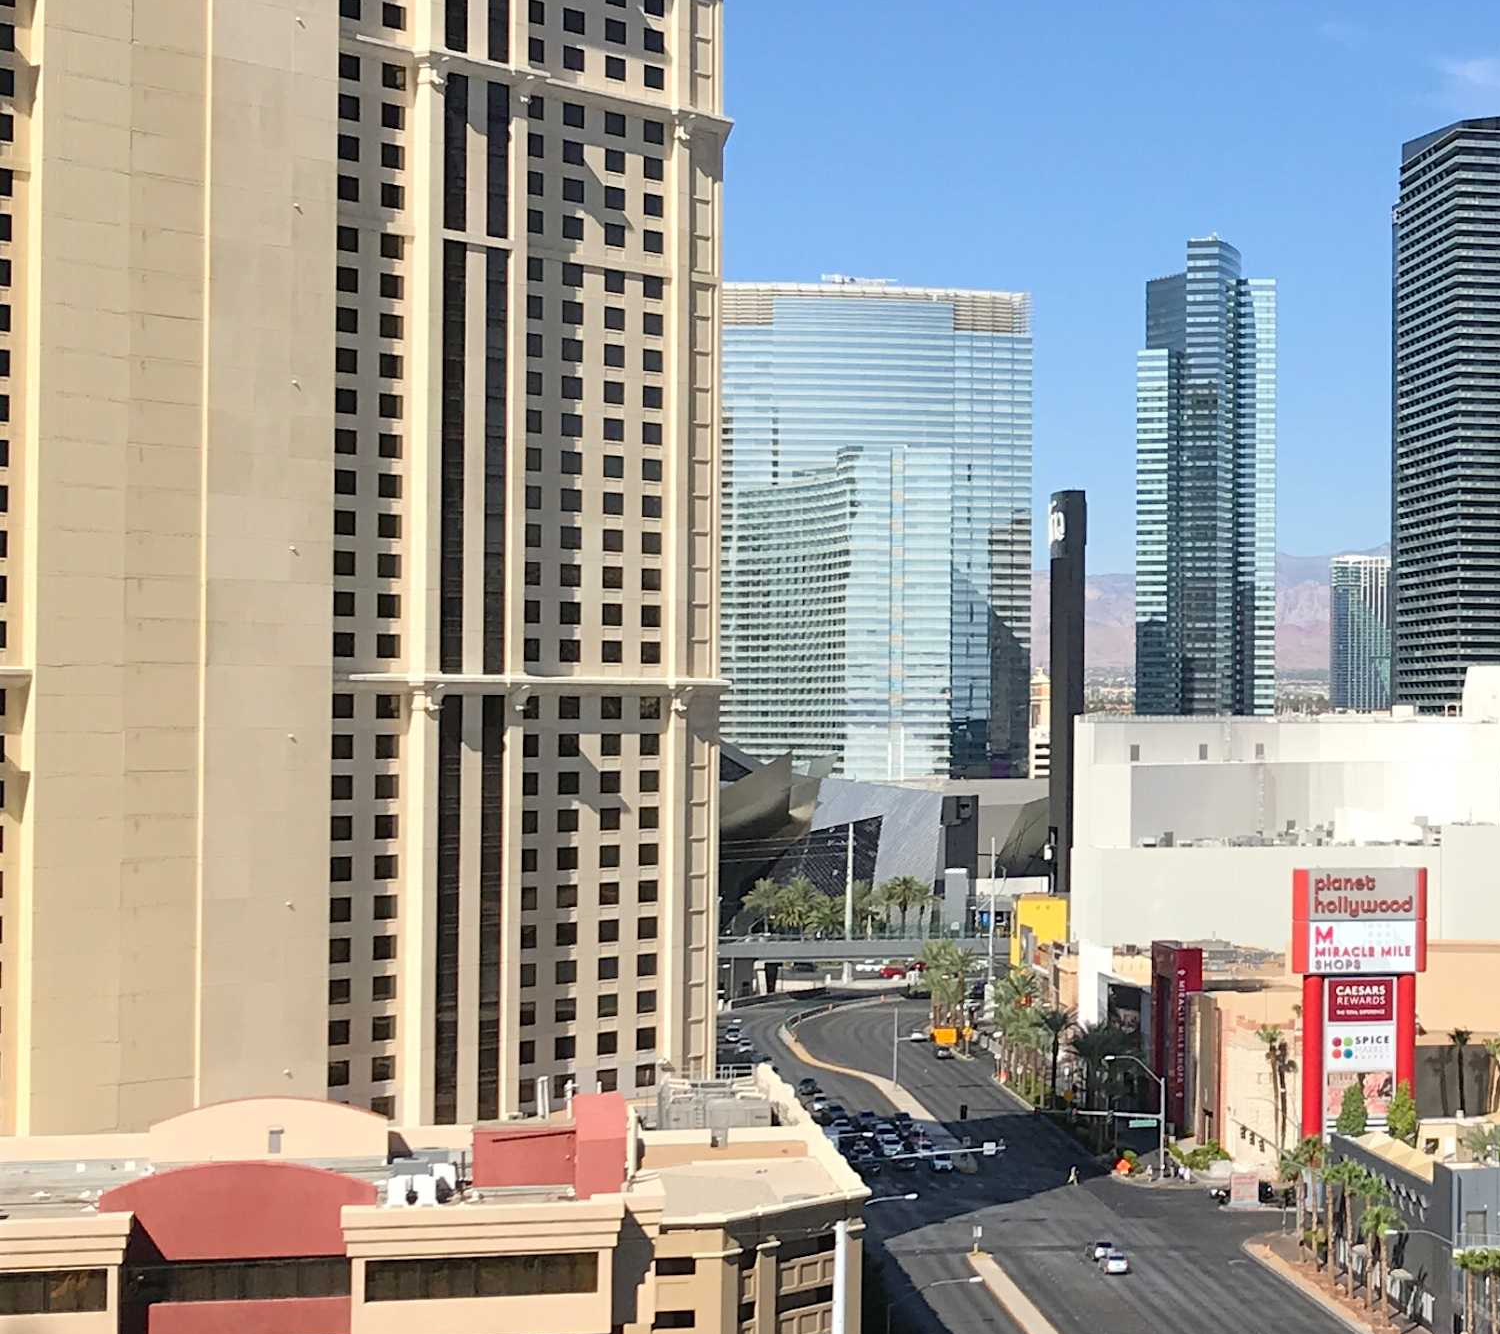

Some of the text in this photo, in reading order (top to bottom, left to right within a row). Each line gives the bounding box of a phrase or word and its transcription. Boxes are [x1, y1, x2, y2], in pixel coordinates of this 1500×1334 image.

[1314, 873, 1376, 895] planet
[1314, 895, 1413, 918] hollywood
[1315, 945, 1412, 958] MIRACLE MILE
[1314, 959, 1361, 971] SHOPS
[1335, 985, 1387, 996] CAESARS
[1336, 995, 1387, 1005] REWARDS
[1354, 1034, 1391, 1045] SPICE
